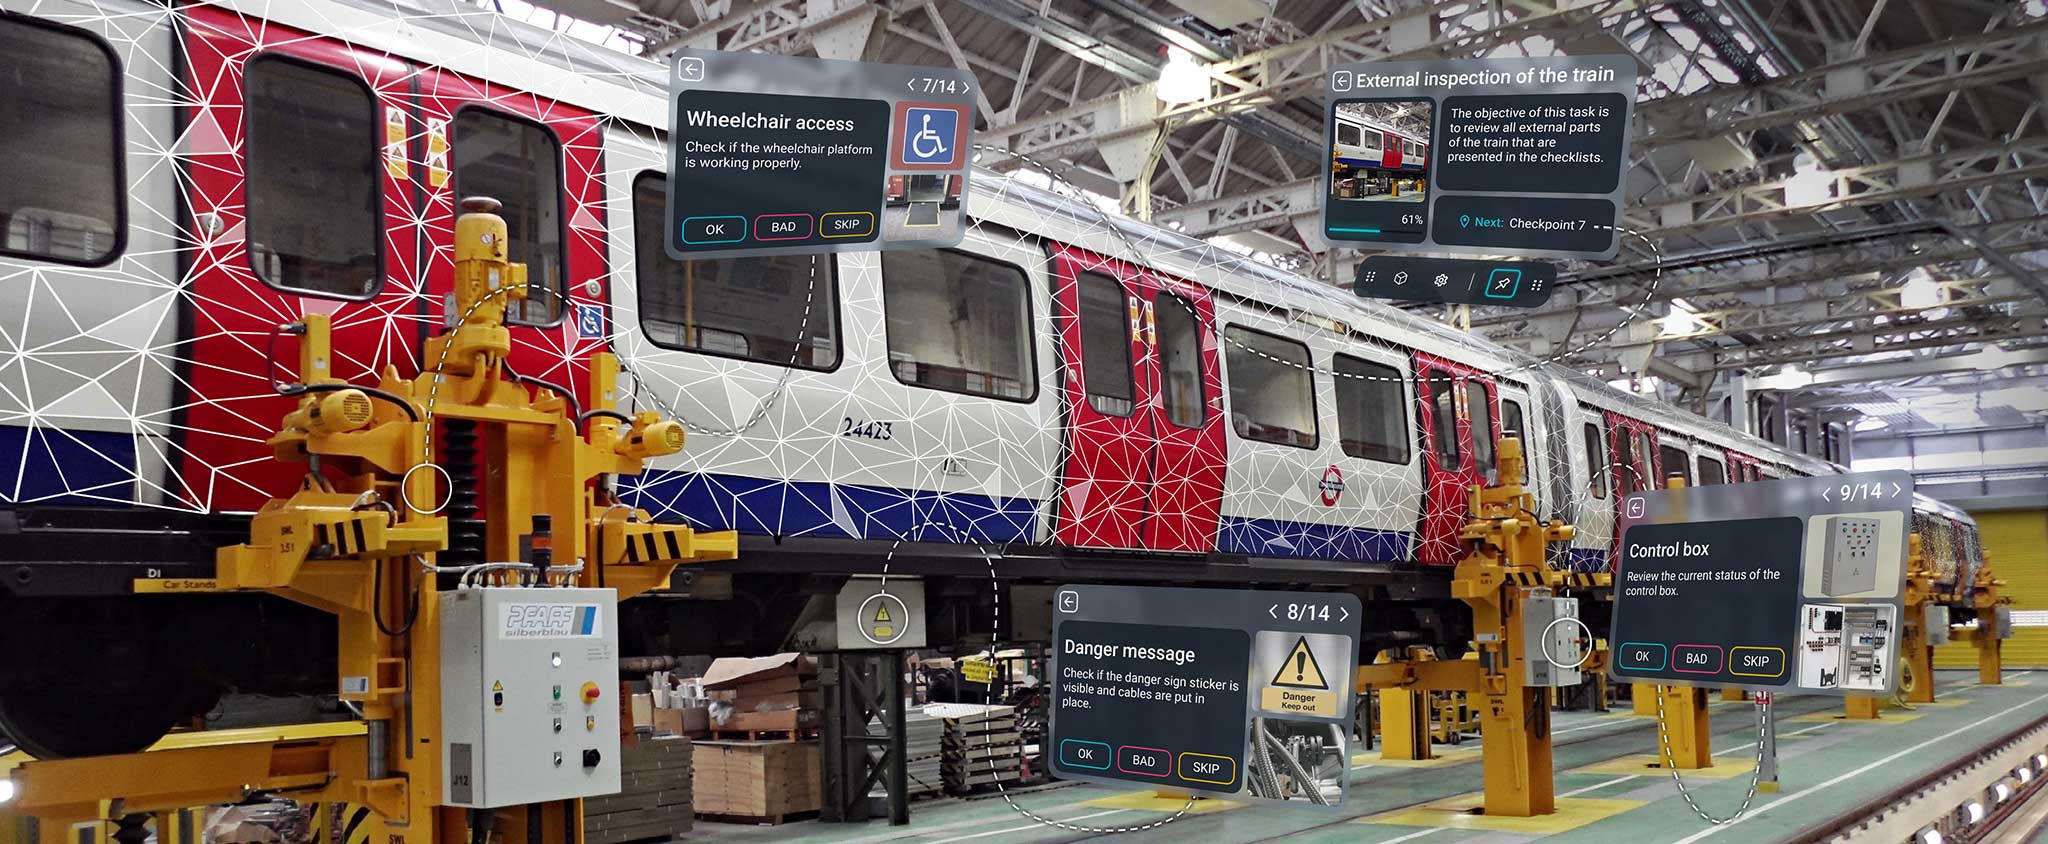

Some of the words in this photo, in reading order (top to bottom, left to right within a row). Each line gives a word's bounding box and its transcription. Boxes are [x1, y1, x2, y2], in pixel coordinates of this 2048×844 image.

[843, 417, 892, 440] 24423
[163, 580, 180, 589] Car
[184, 580, 216, 589] Stands
[507, 605, 573, 628] PFAFF
[505, 628, 568, 636] silberblau
[453, 775, 469, 786] J12
